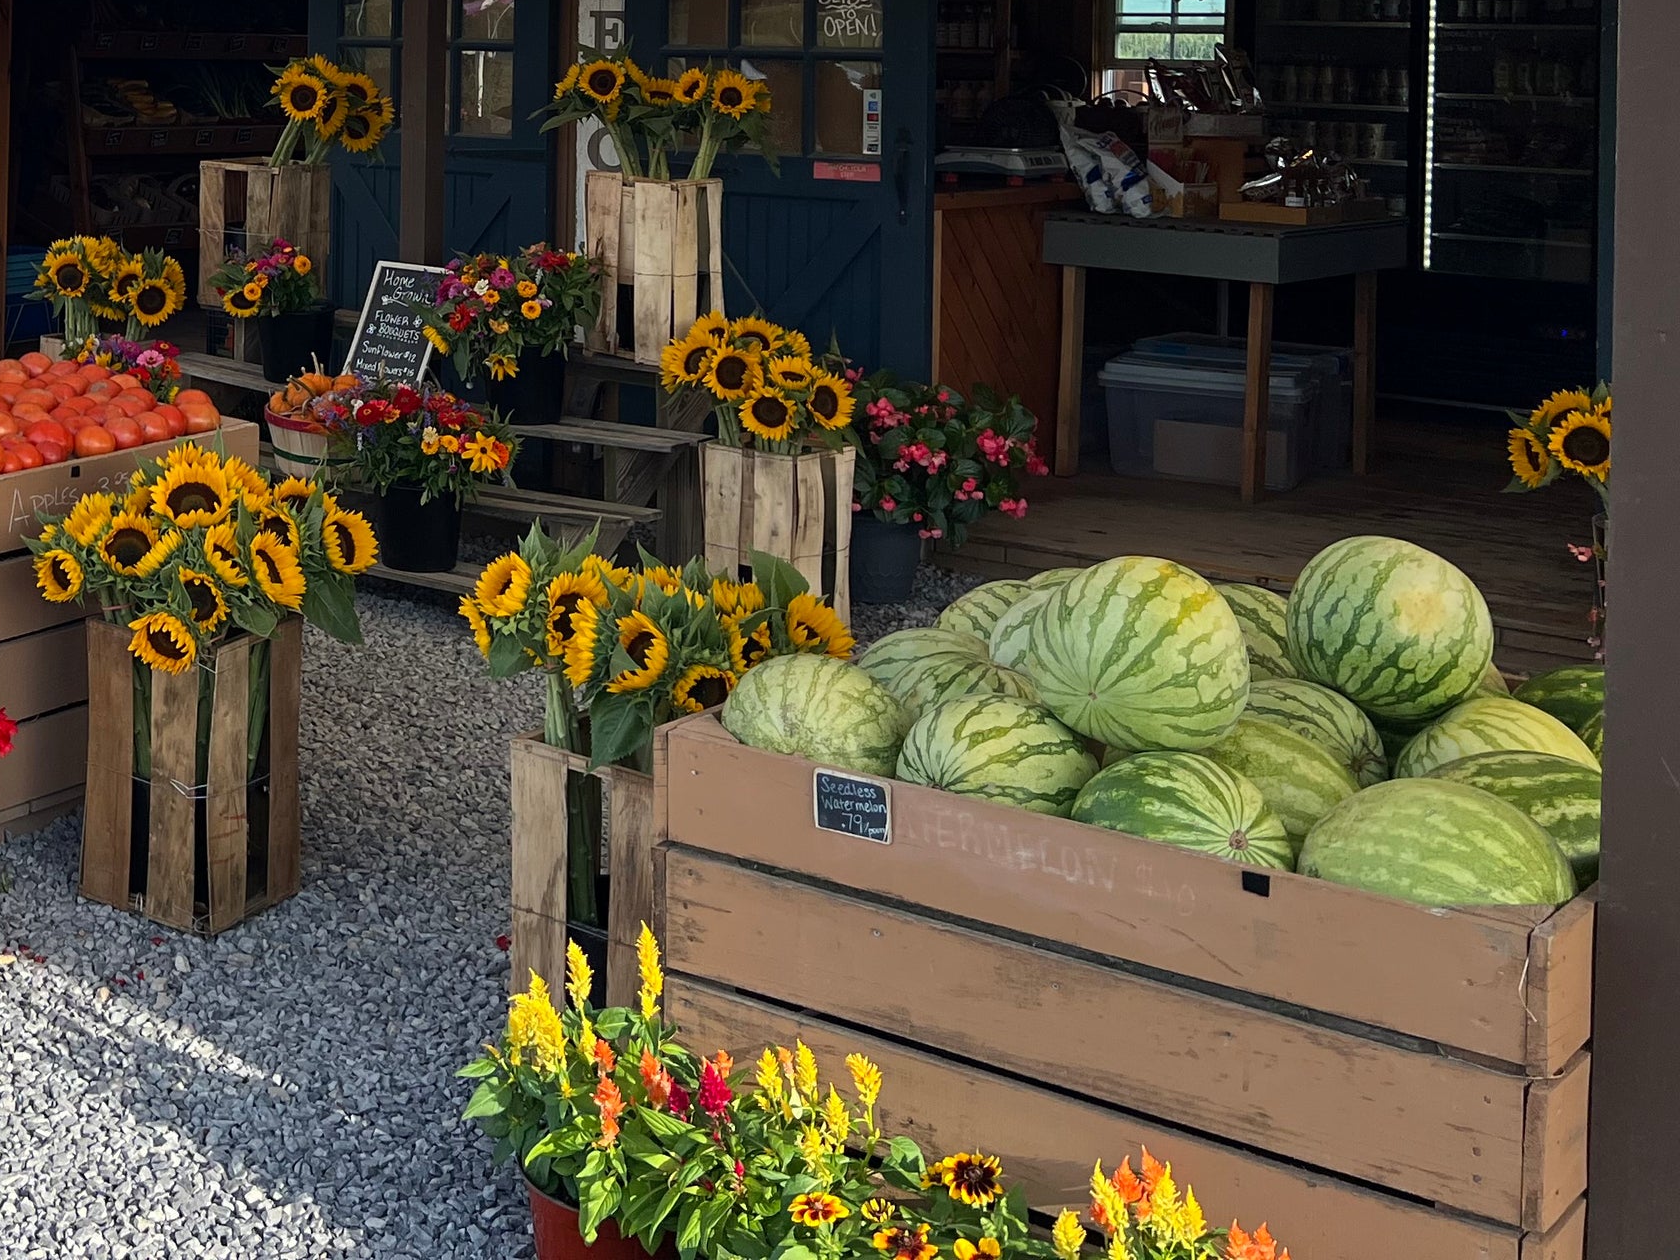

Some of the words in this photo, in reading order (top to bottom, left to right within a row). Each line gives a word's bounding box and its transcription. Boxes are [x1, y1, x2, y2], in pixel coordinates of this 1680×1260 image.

[836, 9, 857, 20] TO
[823, 14, 877, 37] OPEN!
[383, 269, 415, 288] Home
[374, 309, 409, 326] FLOWER
[378, 322, 421, 341] BOUQUETS
[361, 340, 403, 359] Sunflower
[403, 350, 417, 363] $12
[355, 358, 377, 371] Mixed
[8, 486, 80, 533] APPLES
[820, 775, 877, 800] Seedless
[820, 794, 887, 814] Watermelon
[895, 800, 1119, 893] ATERMELON
